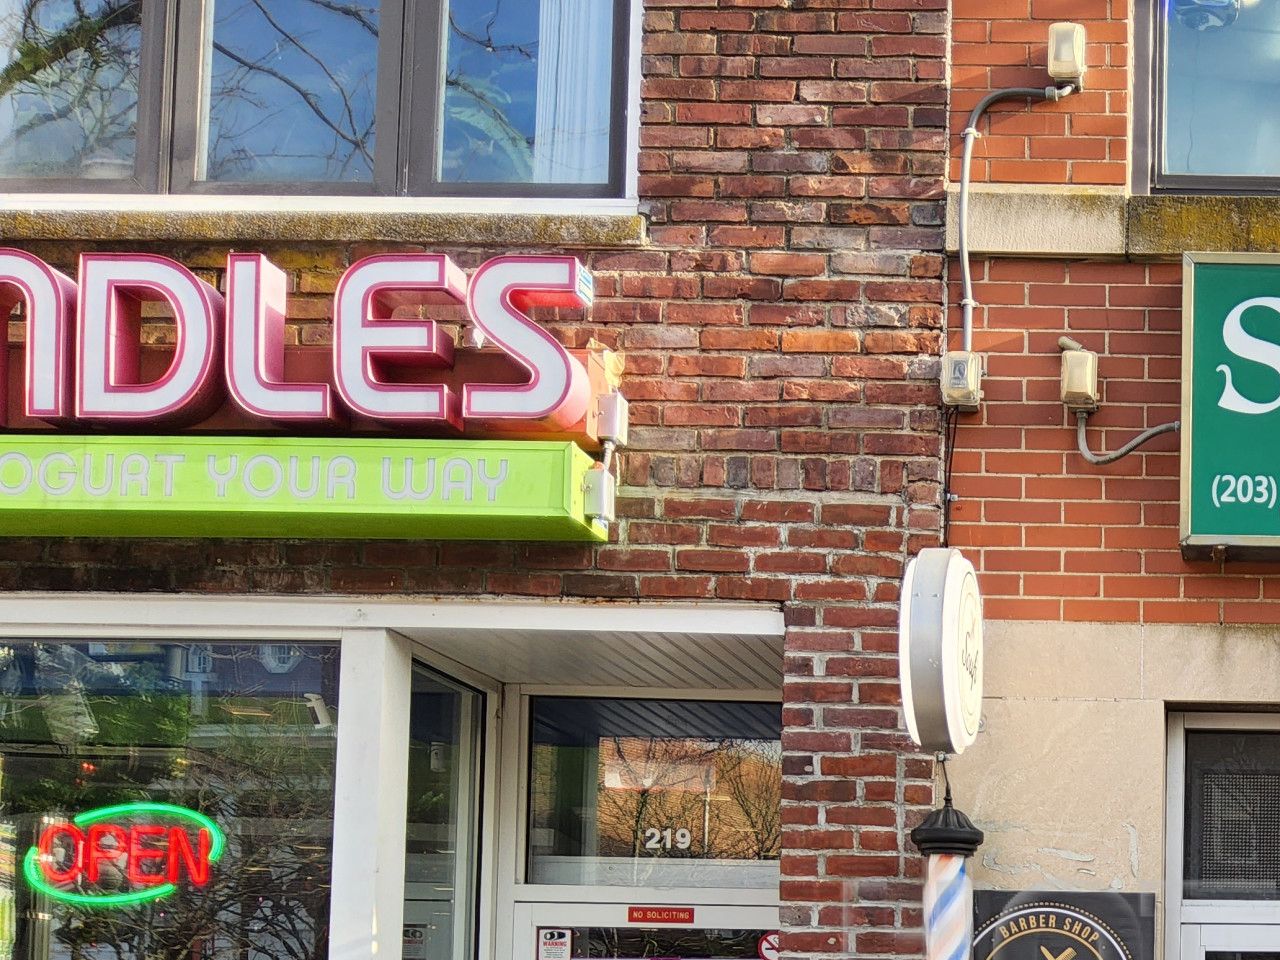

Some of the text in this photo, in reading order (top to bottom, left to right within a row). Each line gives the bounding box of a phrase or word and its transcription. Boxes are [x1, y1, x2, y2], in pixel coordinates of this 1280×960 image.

[206, 453, 357, 500] YOUR
[381, 456, 510, 502] WAY
[1212, 474, 1277, 509] (203)
[645, 828, 691, 850] 219
[37, 823, 211, 887] OPEN
[632, 911, 690, 920] NO SOLICITING
[1000, 914, 1100, 942] BARBER SHOP
